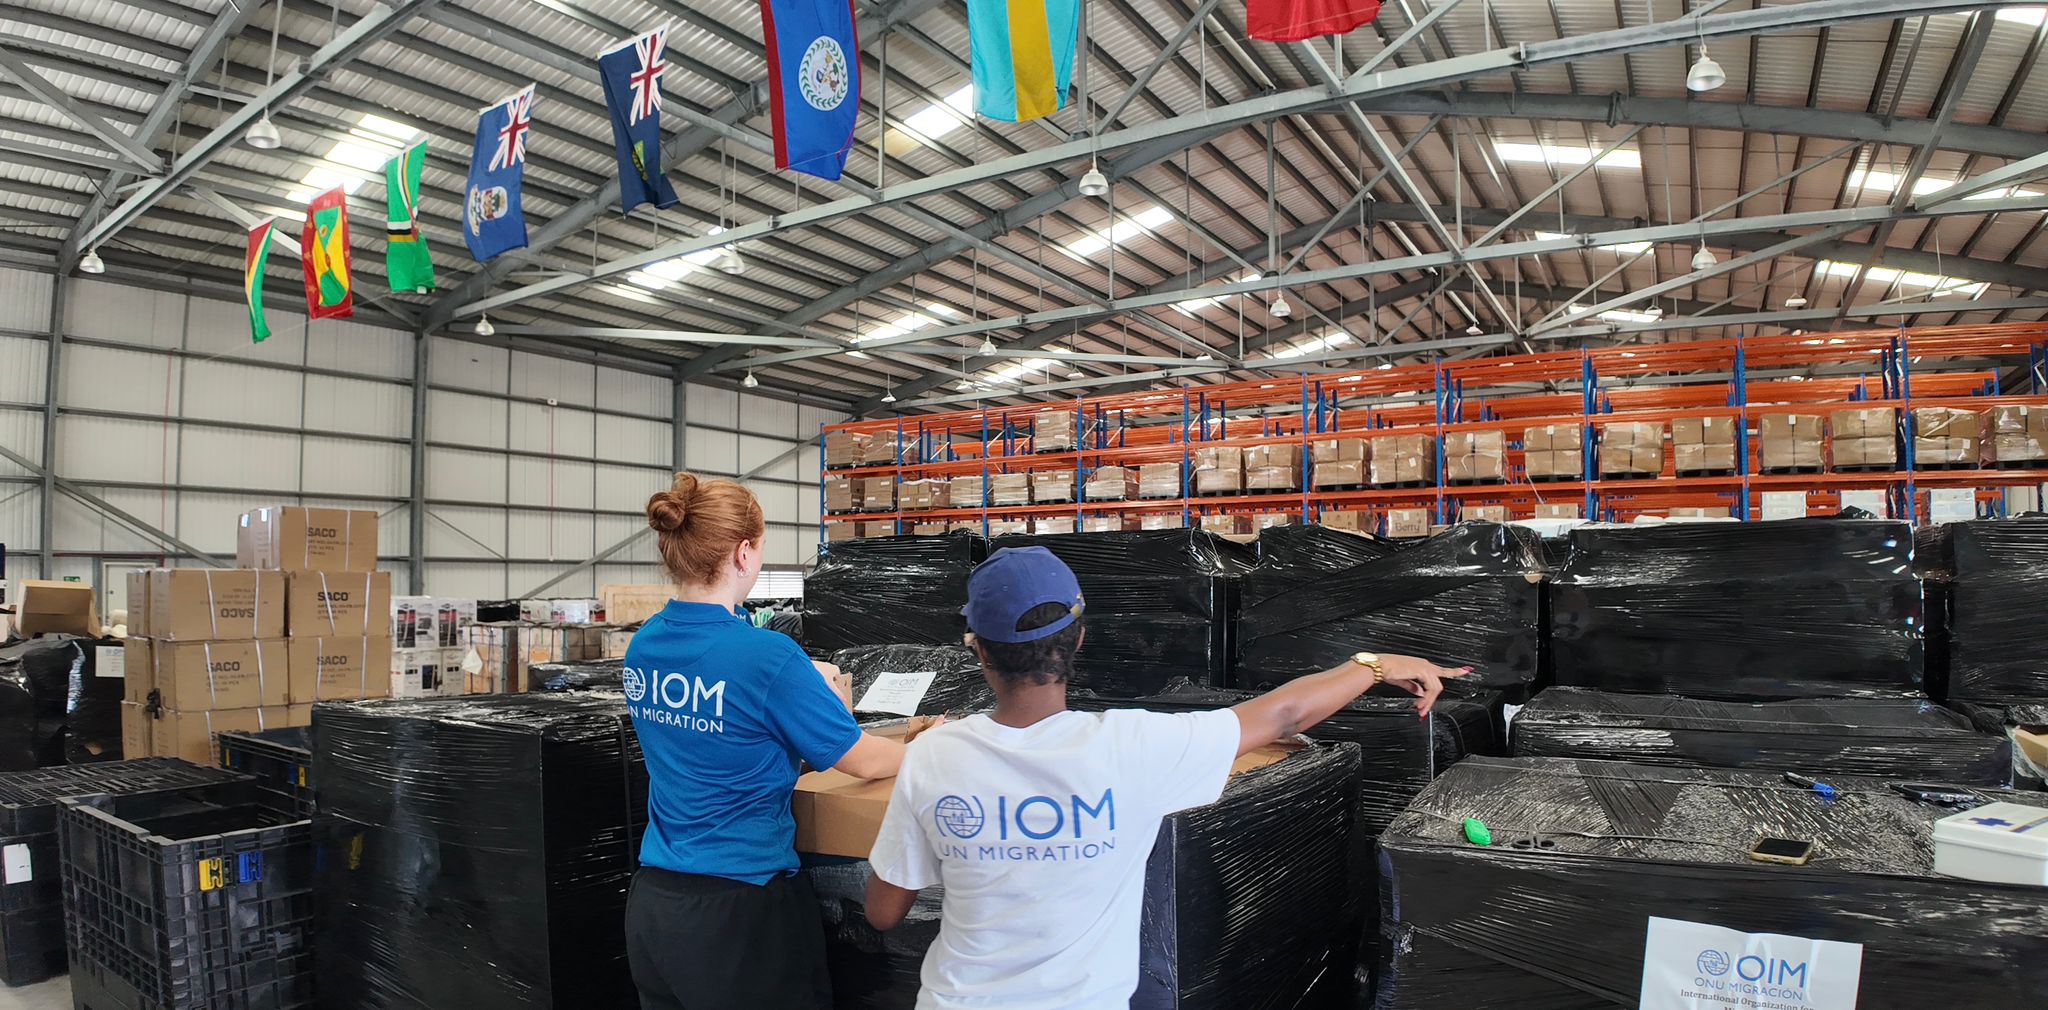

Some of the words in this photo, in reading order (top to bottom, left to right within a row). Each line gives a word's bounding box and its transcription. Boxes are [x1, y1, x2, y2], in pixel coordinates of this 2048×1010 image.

[308, 527, 337, 538] SACO
[1395, 522, 1420, 532] Berry
[318, 591, 349, 602] SACO
[220, 607, 255, 618] SACO
[206, 661, 240, 673] SACO
[316, 655, 347, 666] SACO
[652, 669, 726, 717] IOM
[628, 705, 639, 719] N
[643, 706, 723, 733] MIGRATION
[998, 788, 1115, 840] IOM
[939, 841, 968, 860] UN
[979, 837, 1115, 861] MIGRATION
[1737, 955, 1806, 988] OIM
[1694, 977, 1724, 990] ONU
[1681, 989, 1739, 1004] International
[1741, 998, 1799, 1010] Organization
